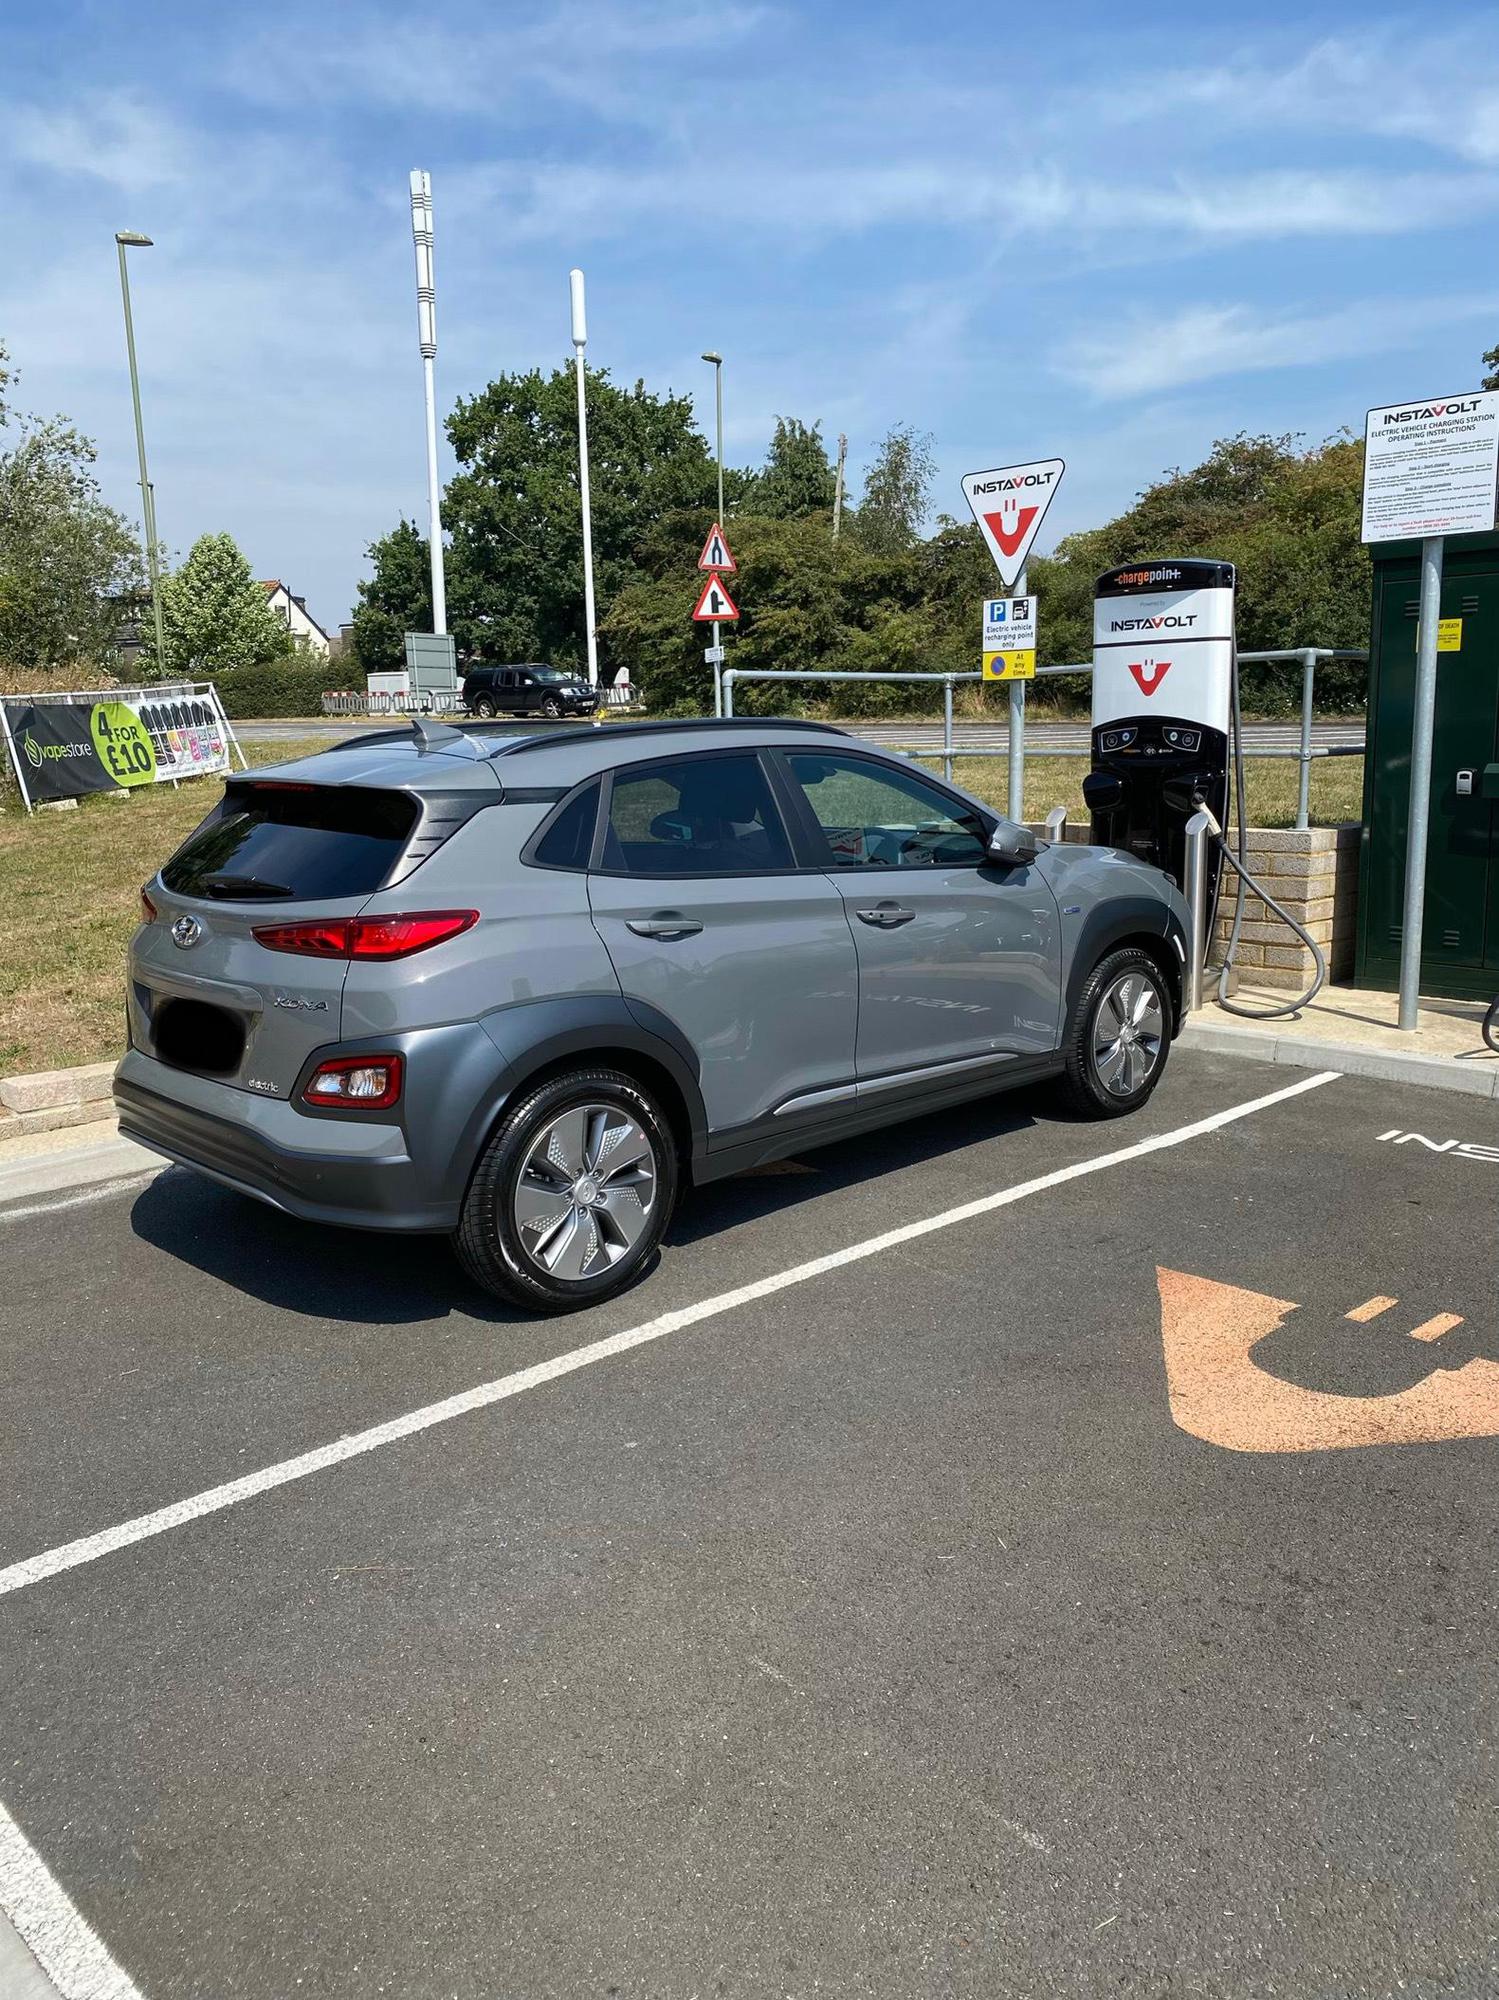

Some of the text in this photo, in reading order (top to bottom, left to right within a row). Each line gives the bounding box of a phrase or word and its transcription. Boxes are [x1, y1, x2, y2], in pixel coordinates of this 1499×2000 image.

[1384, 400, 1481, 424] INSTAVOLT
[1371, 413, 1494, 437] ELECTRIC VEHICLE CHARGING STATION
[1388, 424, 1475, 442] OPERATING INSTRUCTIONS
[973, 472, 1054, 495] INSTAVOLT
[1114, 567, 1181, 585] chargepoint
[994, 604, 1004, 621] P
[1010, 624, 1032, 632] vehicle
[1111, 615, 1198, 632] INSTAVOLT
[985, 632, 1033, 642] recharging point
[98, 711, 140, 743] 4 FOR
[41, 743, 93, 762] vapestore
[107, 741, 152, 776] £10
